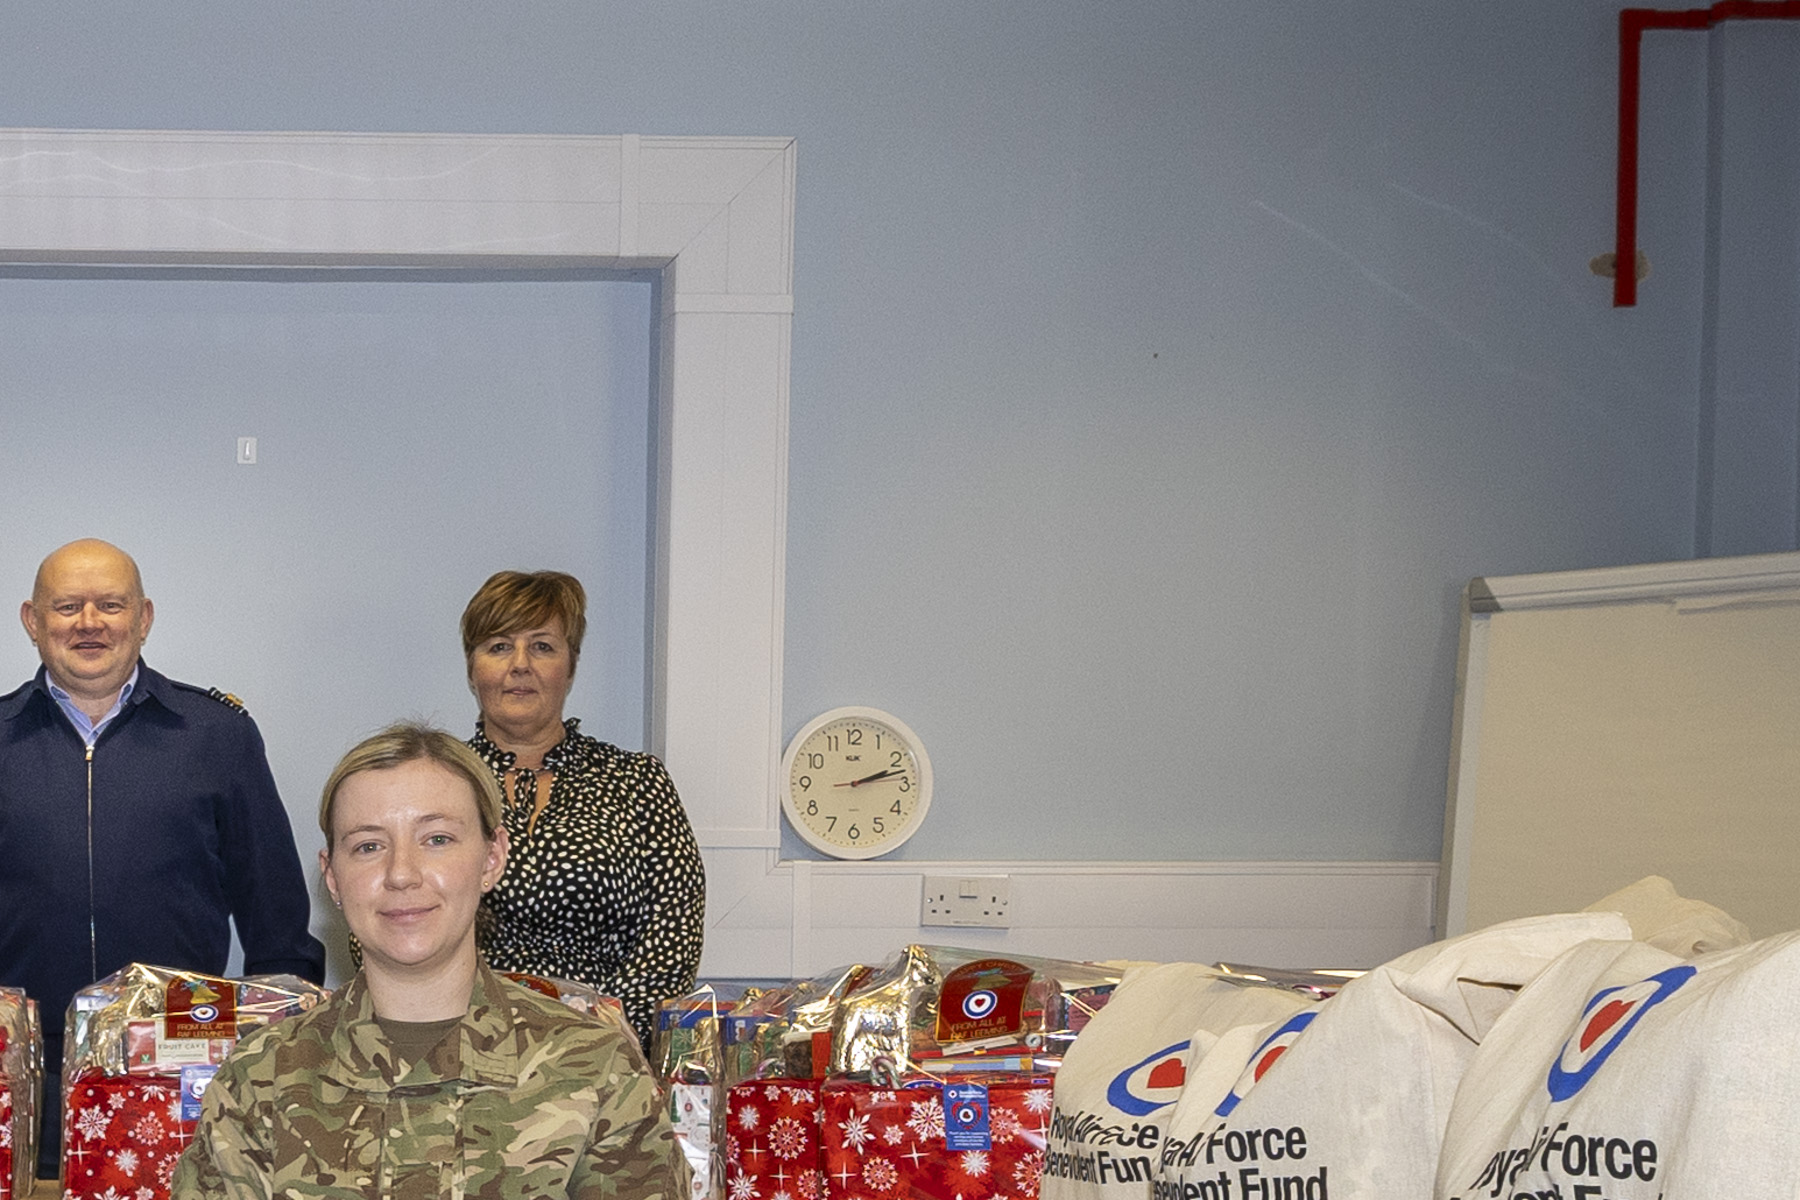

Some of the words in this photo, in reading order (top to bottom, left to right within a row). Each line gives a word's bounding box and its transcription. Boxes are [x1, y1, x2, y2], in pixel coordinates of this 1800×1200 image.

[827, 735, 839, 752] 11
[846, 729, 863, 746] 12
[875, 734, 881, 750] 1
[807, 753, 824, 770] 10
[890, 751, 902, 768] 2
[799, 775, 812, 792] 9
[899, 776, 911, 793] 3
[806, 800, 818, 816] 8
[889, 799, 902, 815] 4
[825, 816, 837, 833] 7
[847, 823, 860, 840] 6
[872, 817, 884, 834] 5
[158, 1043, 181, 1051] FRUIT
[1541, 1121, 1658, 1182] Force
[1097, 1151, 1152, 1184] Fun
